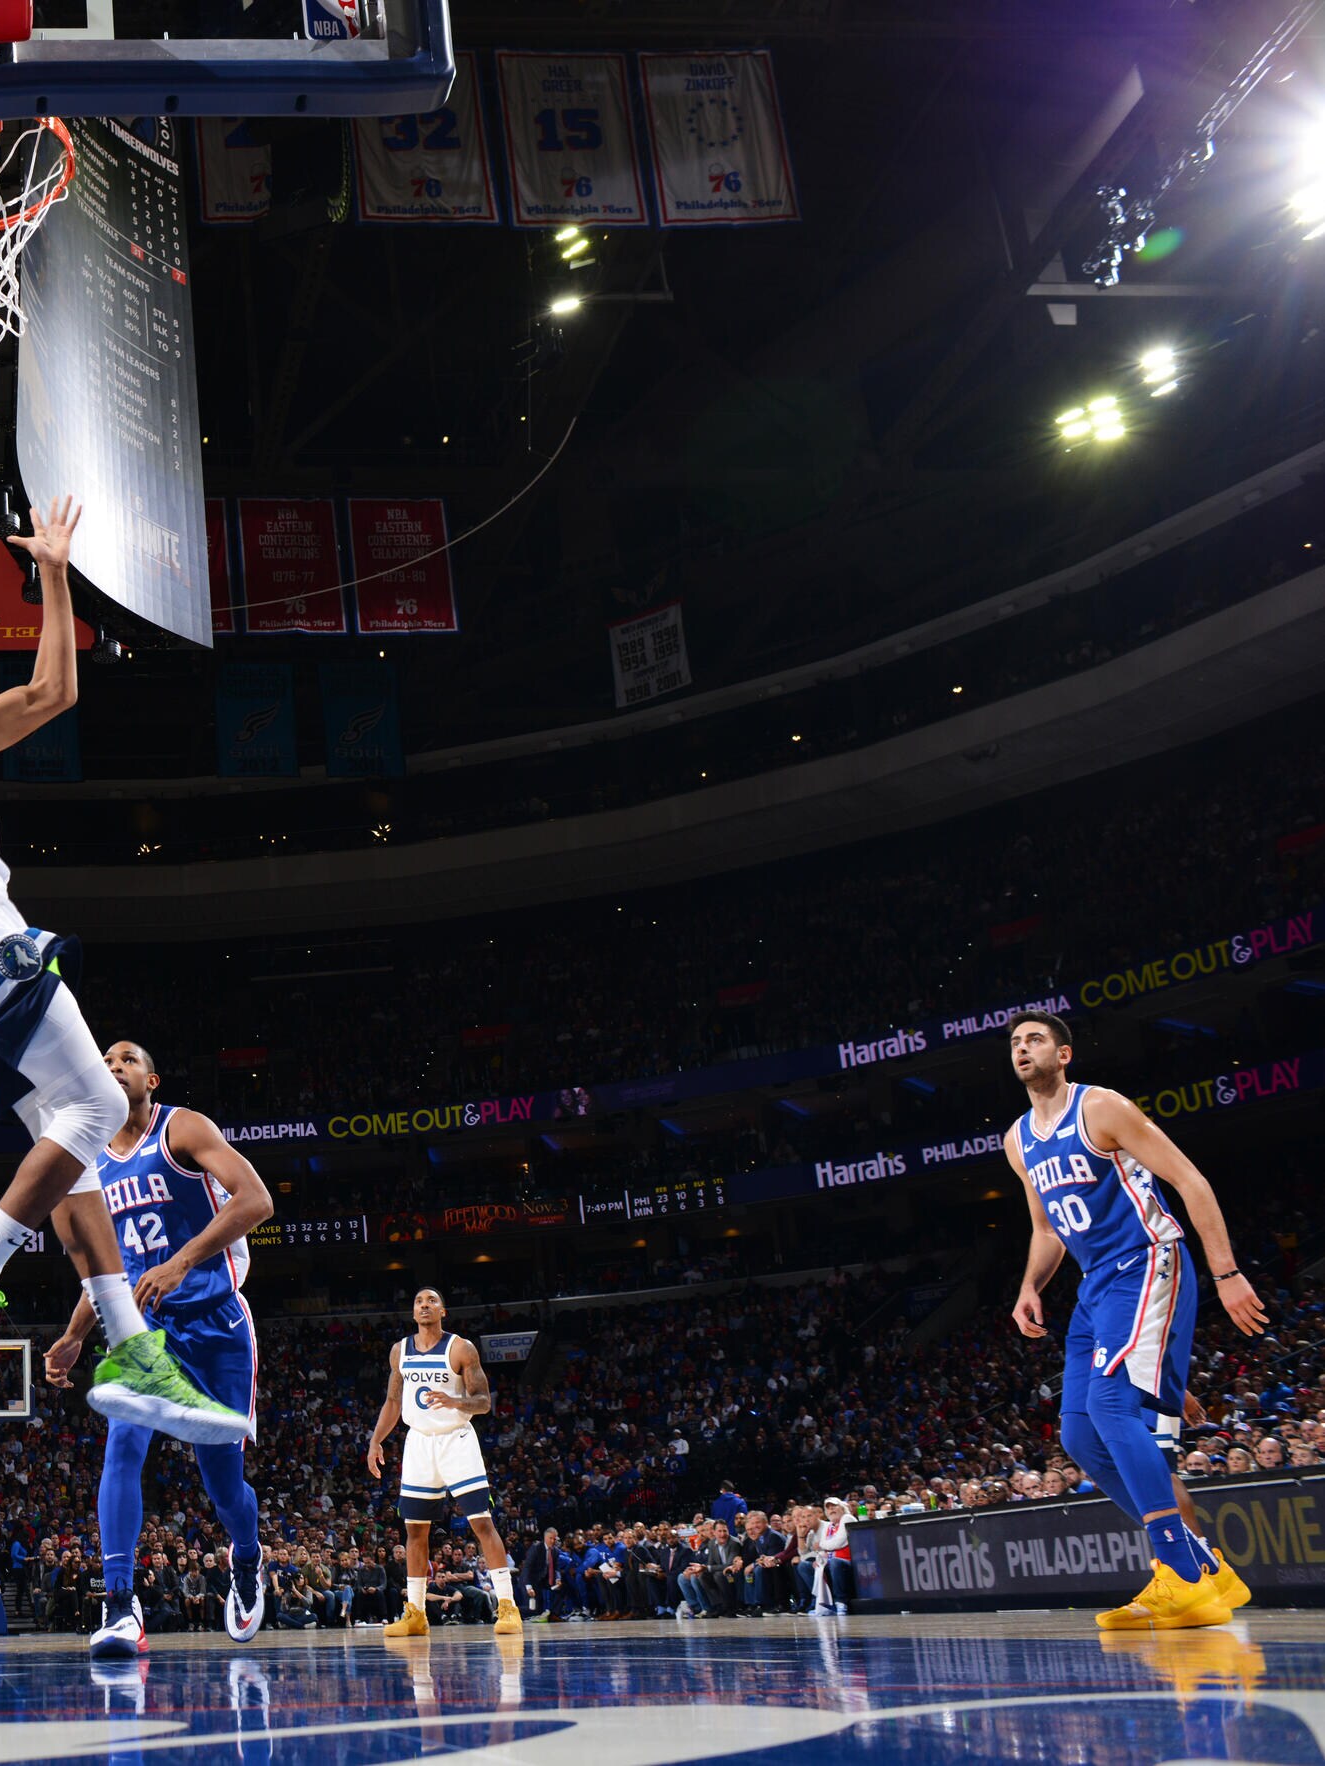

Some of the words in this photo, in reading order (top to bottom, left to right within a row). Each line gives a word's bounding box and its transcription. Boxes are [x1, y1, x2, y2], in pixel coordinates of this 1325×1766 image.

[313, 20, 341, 38] NBA
[548, 65, 572, 78] HAL
[690, 63, 726, 77] DAVID
[542, 79, 583, 92] GREER
[685, 77, 735, 92] ZINKOFF
[380, 107, 461, 152] 32
[535, 108, 603, 151] 15
[81, 127, 119, 168] COVINGTON
[82, 142, 105, 170] TOWNS
[109, 119, 179, 177] TIMBERWOLVES
[411, 178, 442, 198] 76
[562, 176, 593, 197] 76
[709, 171, 742, 193] 76
[527, 203, 599, 216] Philadelphia
[602, 204, 633, 215] 76ers
[676, 199, 748, 211] Philadelphia
[752, 198, 783, 210] 76ers
[94, 217, 119, 242] TOTALS
[104, 254, 126, 281] TEAM
[125, 271, 150, 293] STATS
[104, 336, 125, 360] TEAM
[125, 353, 160, 381] LEADERS
[113, 363, 141, 388] TOWNS
[114, 379, 148, 407] WIGGINS
[112, 393, 143, 420] TEAGUE
[115, 411, 161, 445] COVINGTON
[386, 509, 408, 520] NBA
[376, 521, 422, 533] EASTERN
[259, 534, 322, 546] CONFERENCE
[368, 534, 432, 547] CONFERENCE
[262, 547, 321, 560] CHAMPIONS
[395, 599, 418, 615] 76
[1079, 959, 1169, 1009] COME
[328, 1112, 409, 1139] COME
[922, 1134, 1007, 1166] PHILADEL
[1028, 1154, 1097, 1194] PHILA
[103, 1173, 174, 1214] HILA
[634, 1196, 650, 1207] PHI
[657, 1194, 668, 1203] 23
[523, 1201, 557, 1214] Nov.
[585, 1202, 606, 1213] 7:49
[608, 1201, 623, 1211] PM
[634, 1207, 653, 1217] MIN
[1049, 1194, 1092, 1236] 30
[444, 1204, 517, 1231] FLEETWOOD
[465, 1218, 494, 1234] MAC
[124, 1212, 169, 1255] 42
[250, 1225, 281, 1235] PLAYER
[285, 1223, 297, 1233] 33
[301, 1222, 312, 1232] 32
[316, 1222, 328, 1231] 22
[251, 1236, 281, 1246] POINTS
[489, 1336, 532, 1348] GEICO
[404, 1372, 449, 1383] WOLVES
[1005, 1530, 1154, 1577] PHILADELPHI
